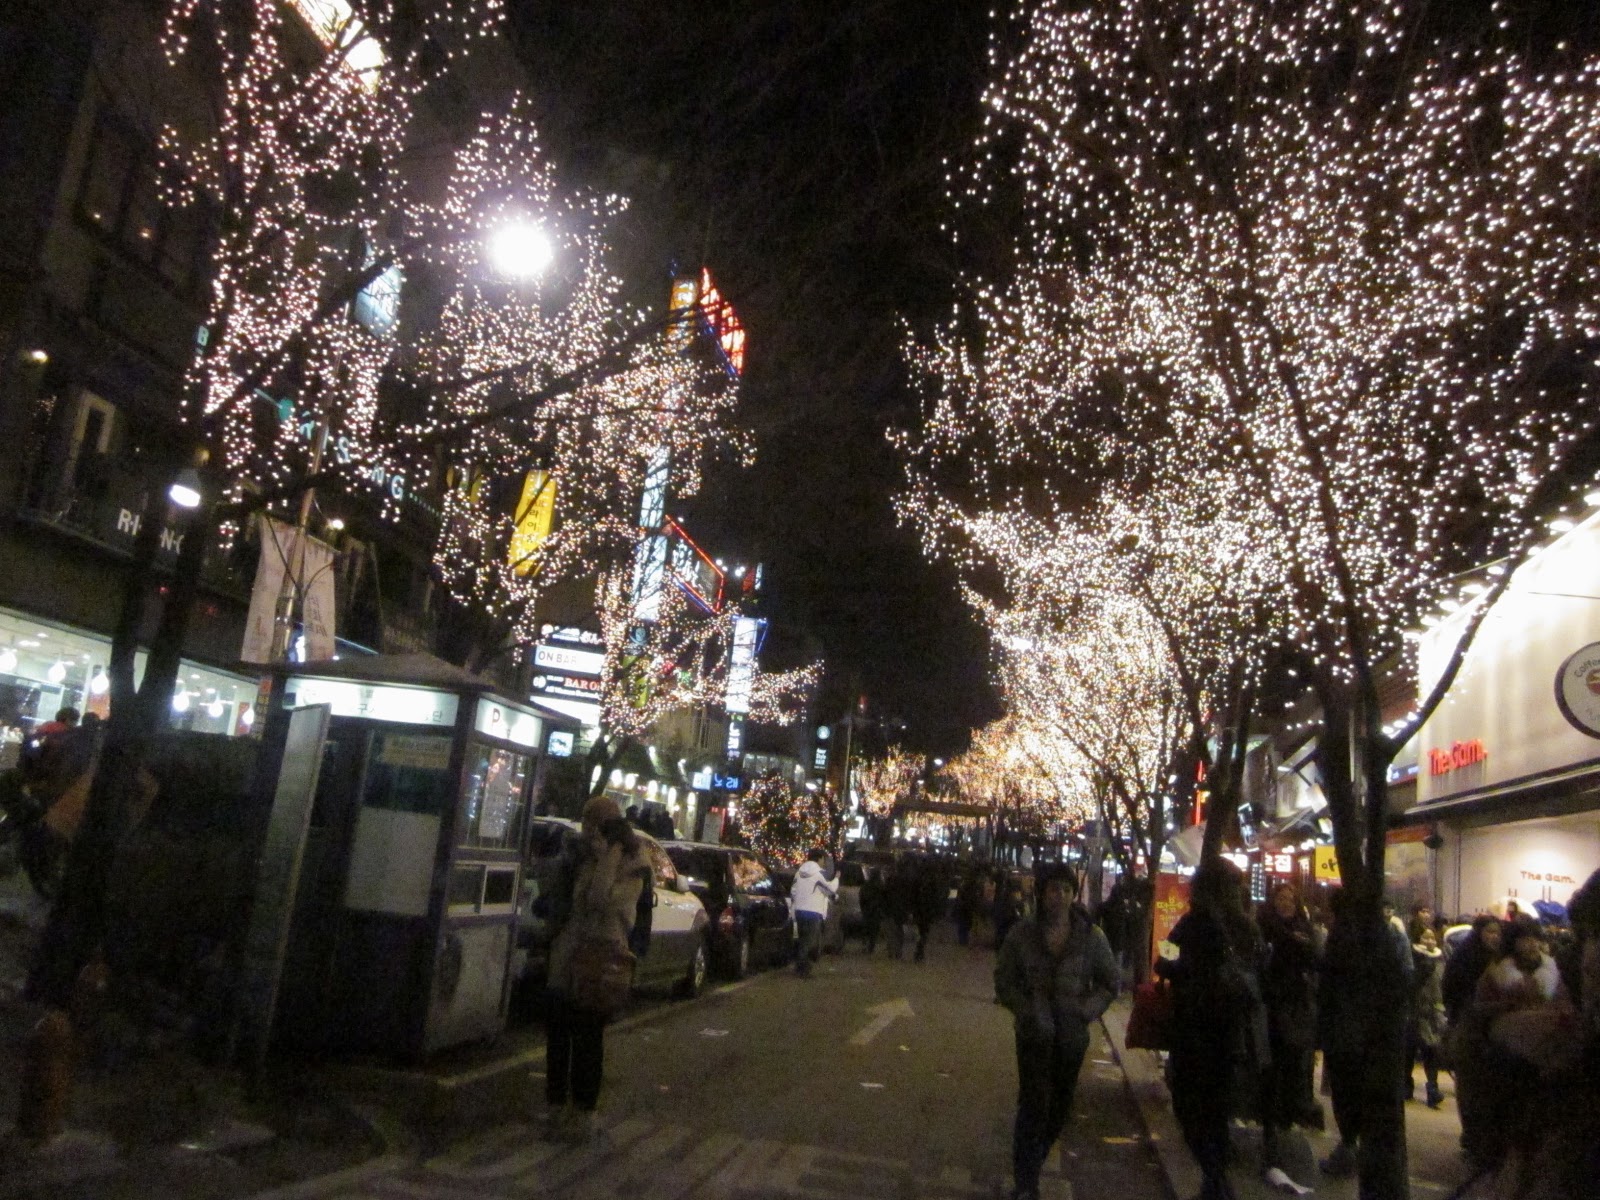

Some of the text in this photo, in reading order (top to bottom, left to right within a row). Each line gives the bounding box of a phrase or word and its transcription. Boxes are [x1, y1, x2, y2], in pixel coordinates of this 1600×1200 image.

[538, 650, 554, 662] ON
[1428, 747, 1449, 777] The
[1520, 870, 1542, 881] The
